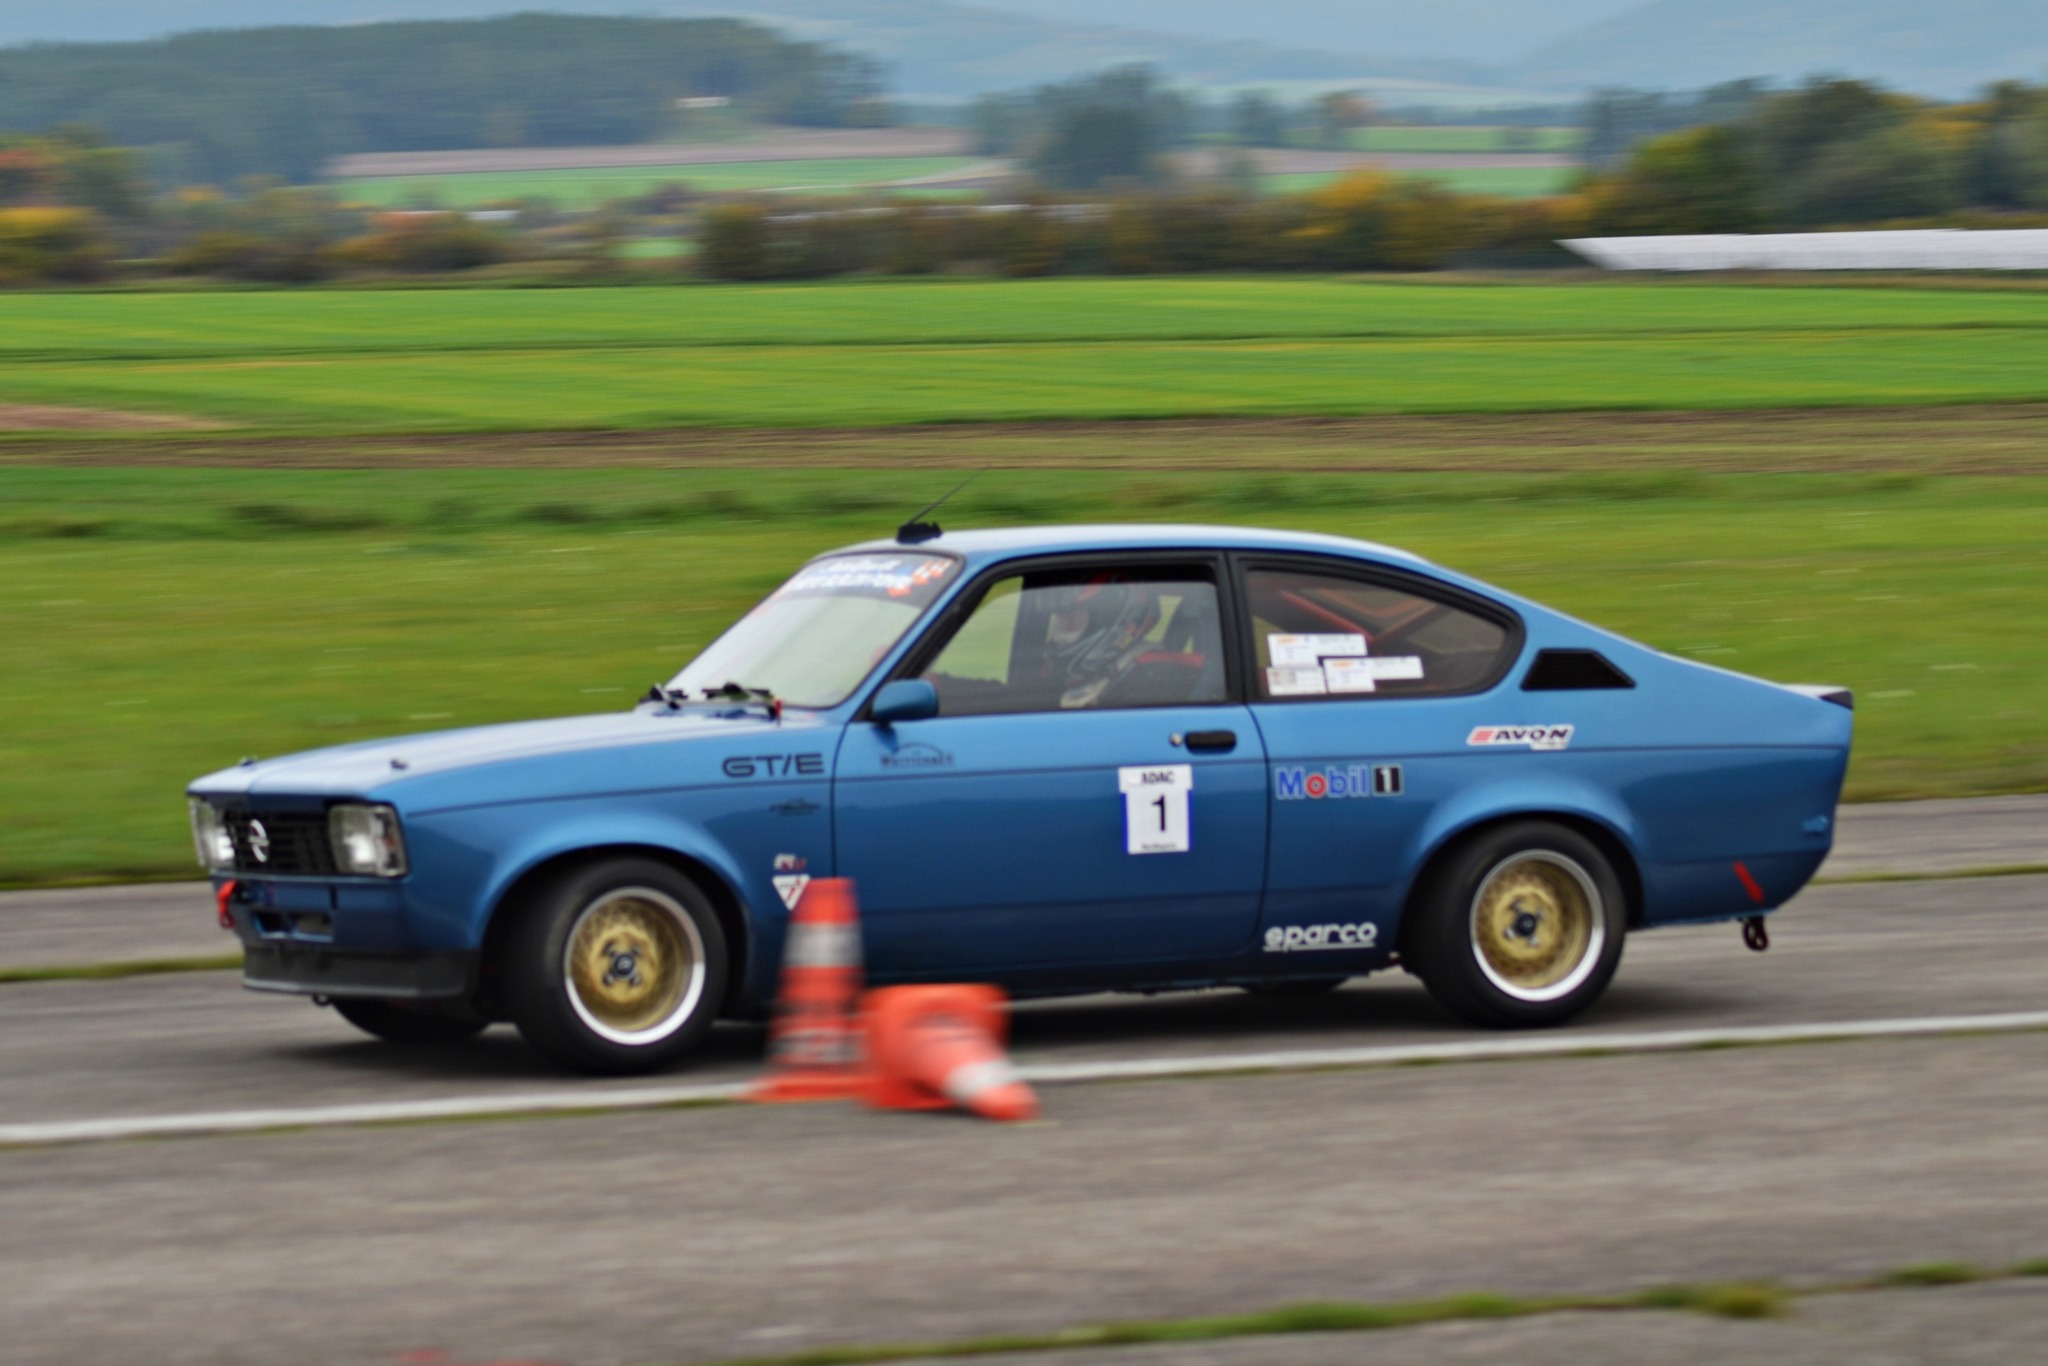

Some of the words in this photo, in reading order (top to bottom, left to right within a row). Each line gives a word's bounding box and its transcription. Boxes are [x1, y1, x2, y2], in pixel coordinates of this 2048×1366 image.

[1495, 728, 1570, 742] AVON
[722, 753, 824, 778] GT/E
[1142, 769, 1175, 784] ADAC
[1276, 765, 1370, 799] Mobil
[1151, 794, 1168, 832] 1
[1264, 922, 1378, 951] sparco
